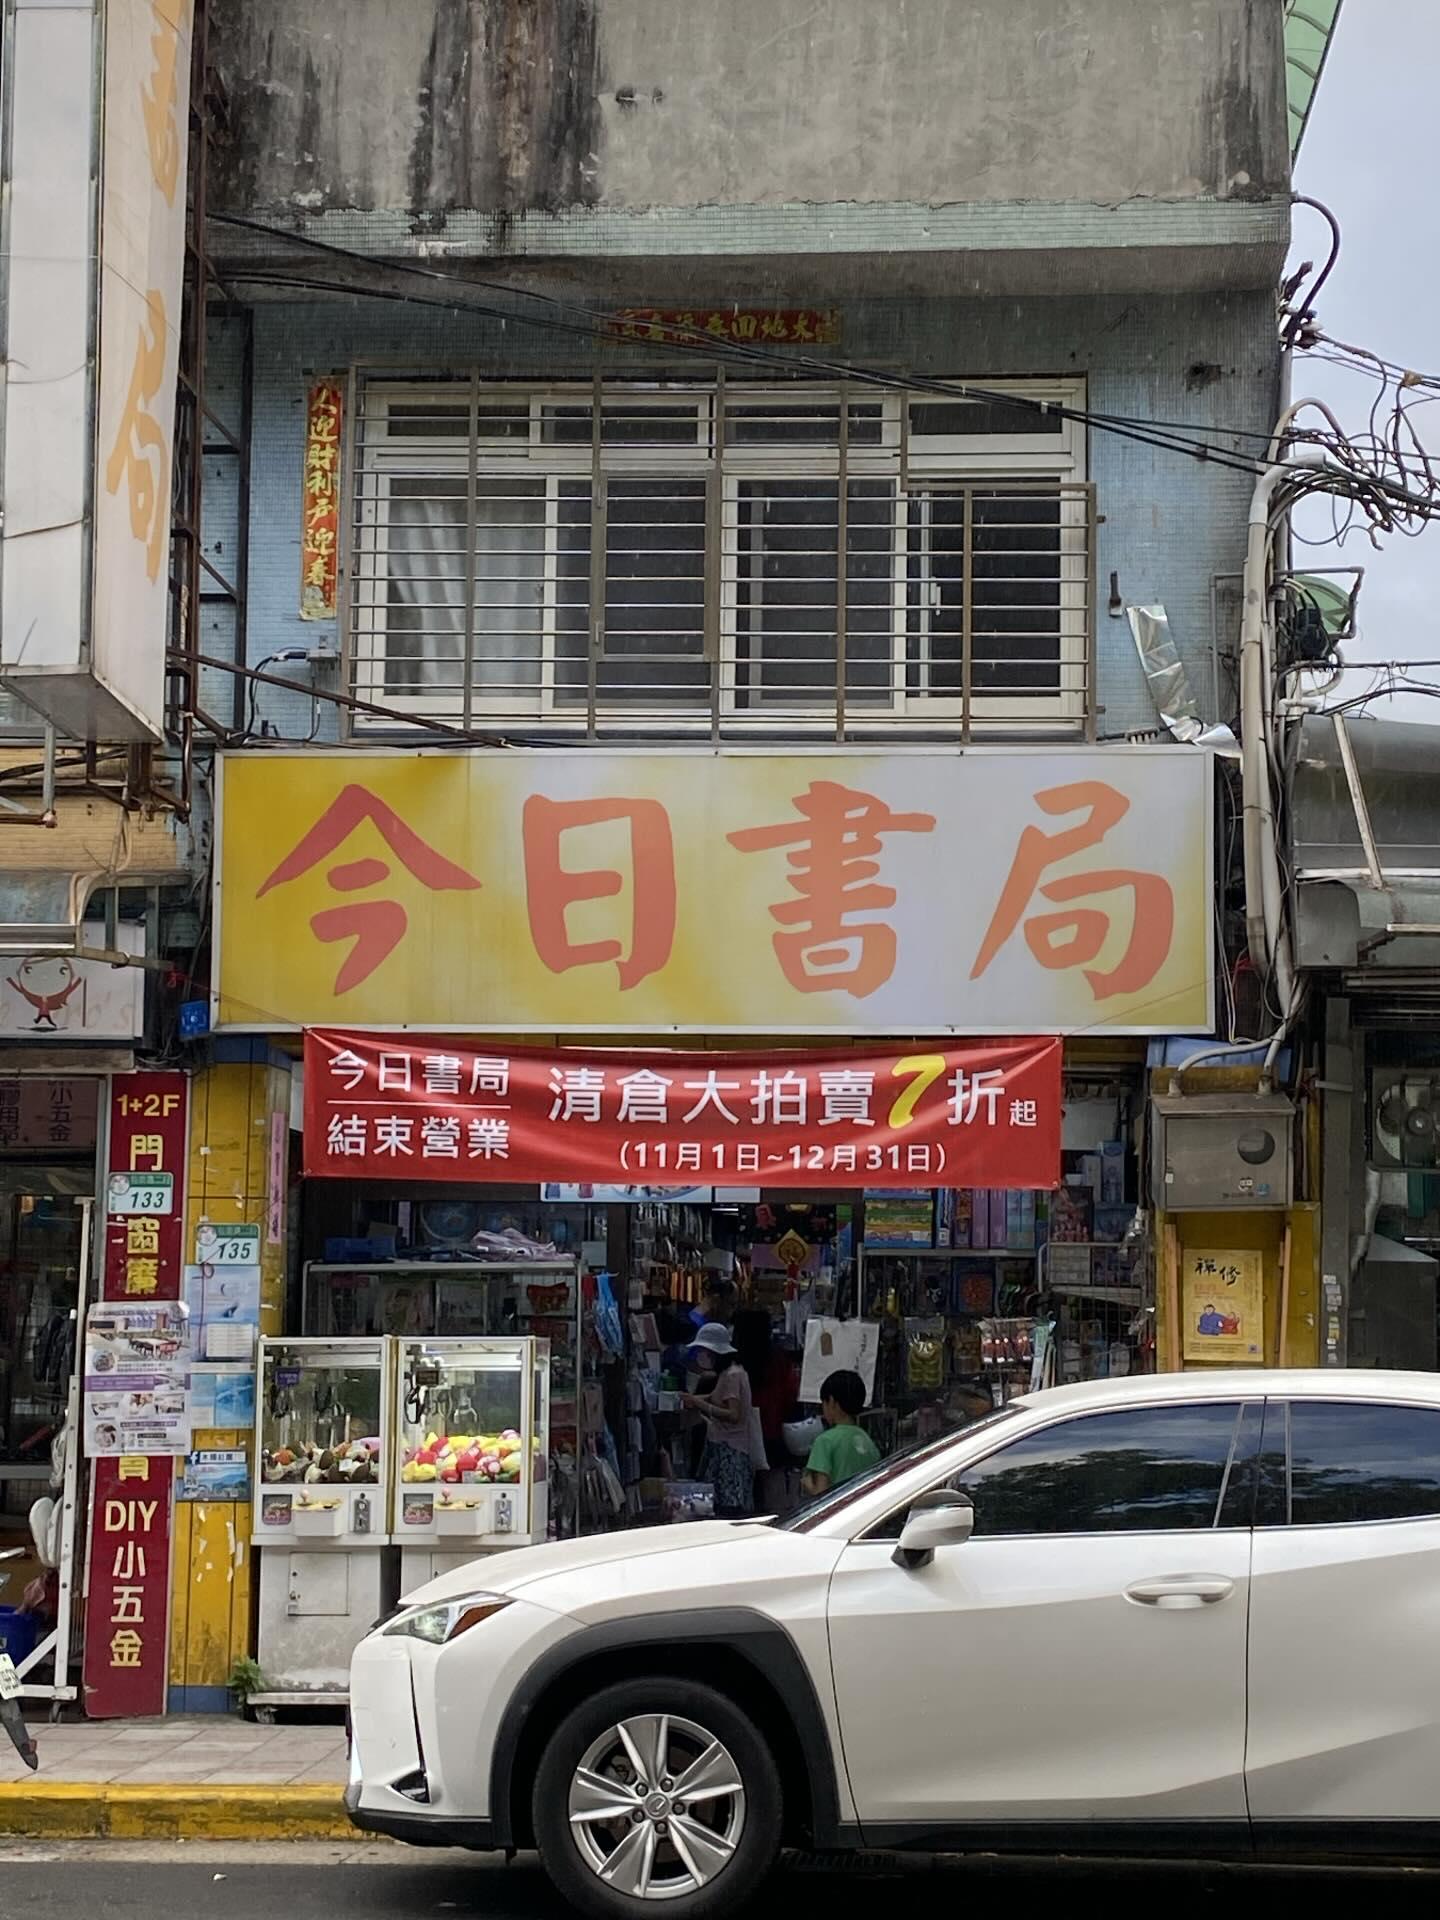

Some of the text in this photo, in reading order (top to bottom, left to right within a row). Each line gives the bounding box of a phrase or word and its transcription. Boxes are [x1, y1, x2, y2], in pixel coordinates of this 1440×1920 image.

[256, 781, 1174, 1000] 今日書局
[328, 1049, 510, 1097] 今日書局
[117, 1094, 180, 1117] 1+2F
[328, 1114, 510, 1160] 結束營業
[620, 1141, 947, 1174] (11月1日~12月31日)
[131, 1192, 165, 1208] 133
[218, 1243, 251, 1260] 135
[105, 1501, 158, 1531] DIY
[110, 1541, 144, 1667] 小五金
